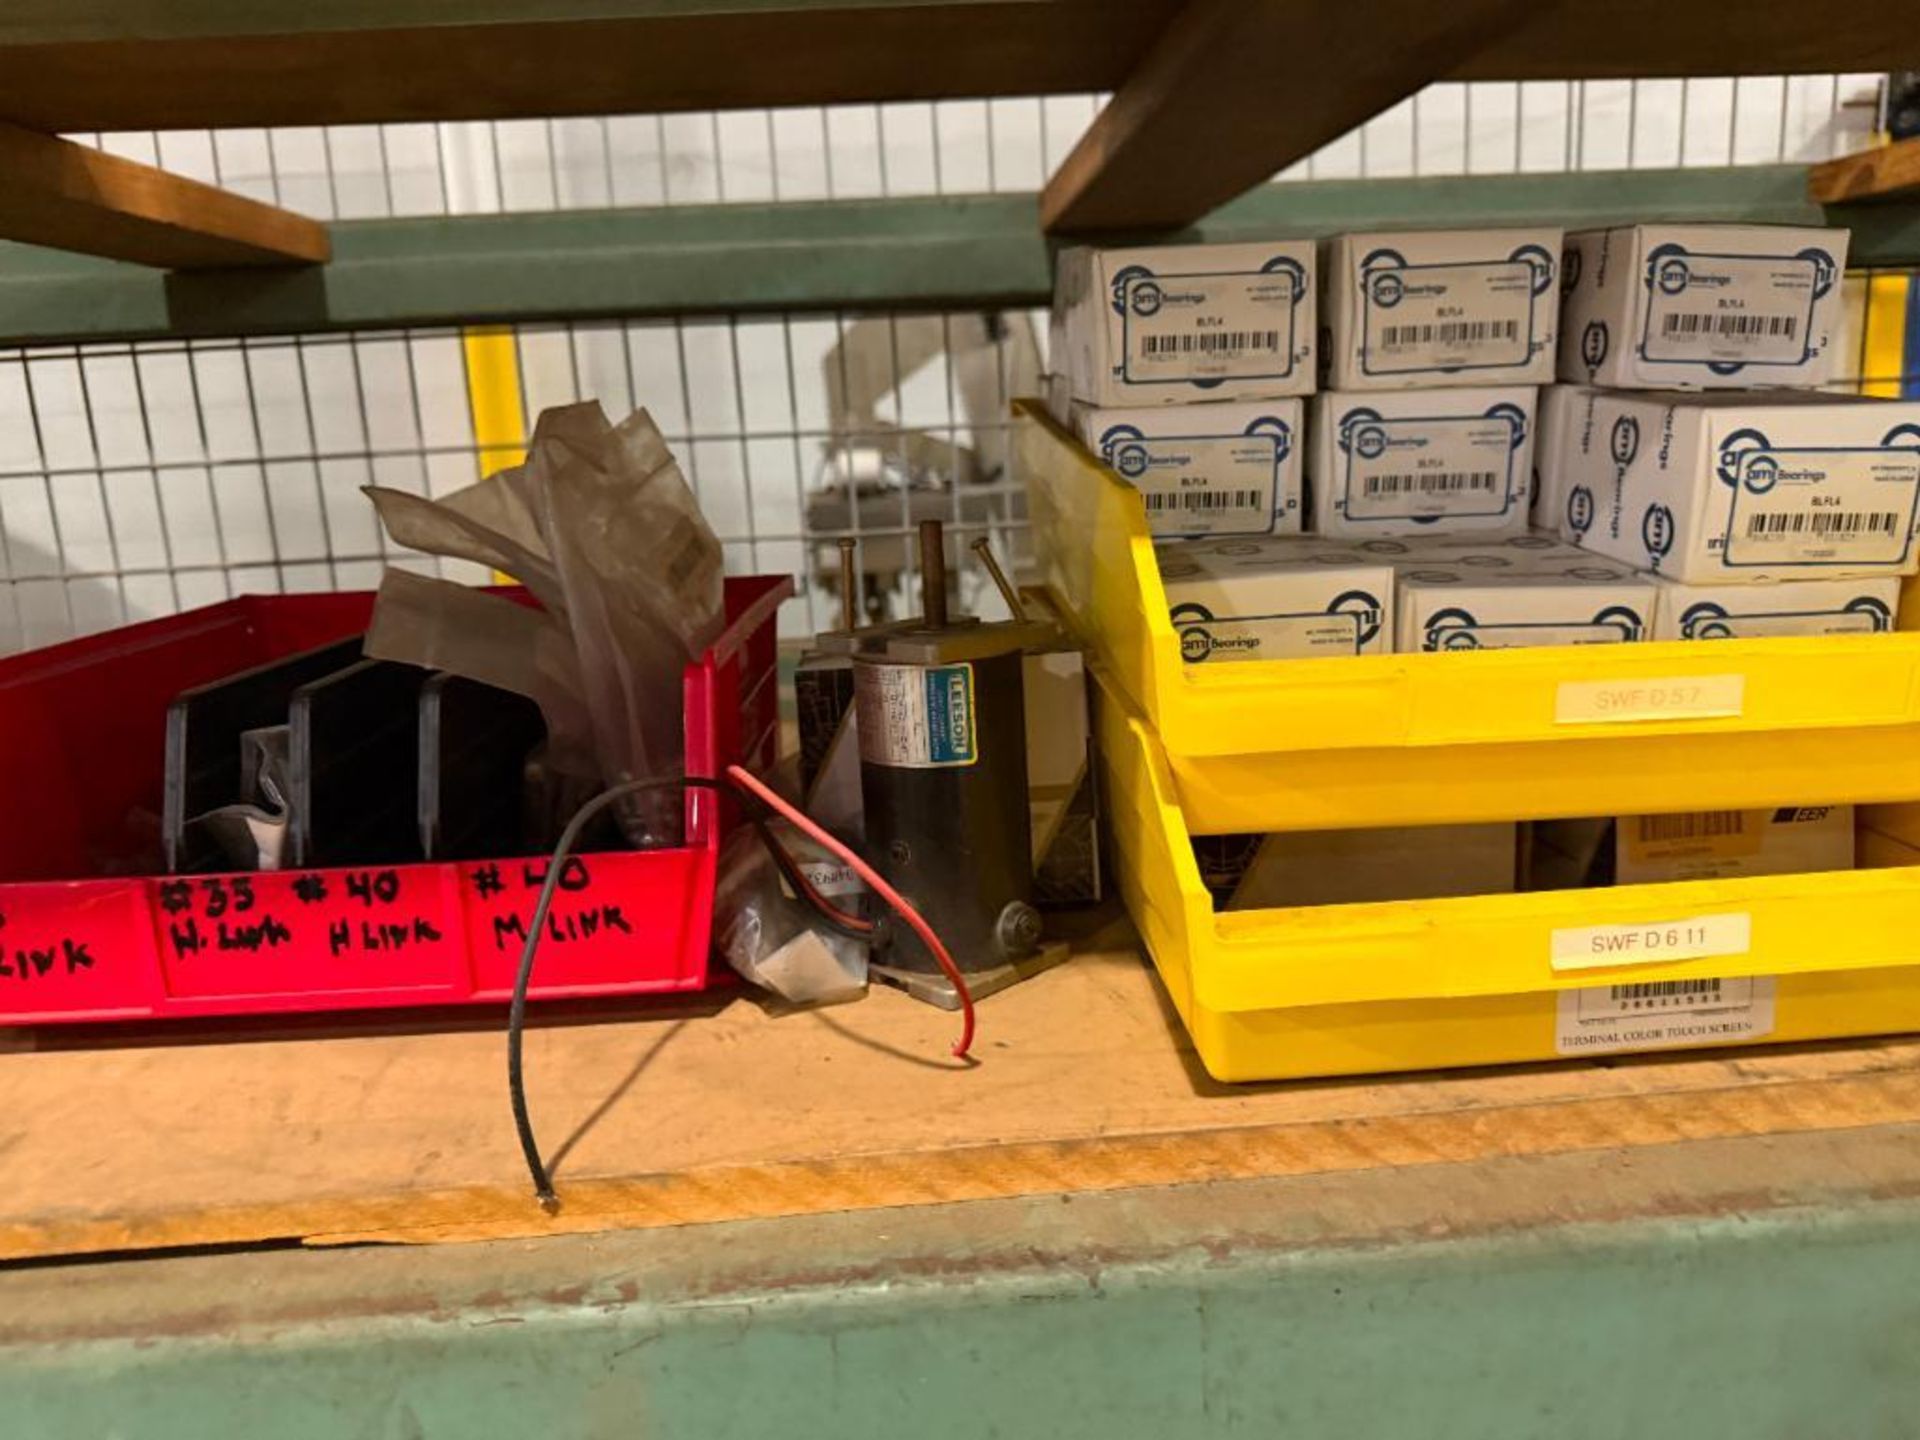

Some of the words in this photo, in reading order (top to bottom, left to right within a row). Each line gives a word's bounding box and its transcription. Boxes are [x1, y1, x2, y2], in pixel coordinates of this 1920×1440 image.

[1778, 468, 1826, 484] Bearings
[1811, 495, 1841, 507] BLFL4
[1211, 635, 1260, 649] Bearings
[1593, 689, 1645, 710] SWF
[1650, 688, 1666, 707] D
[949, 678, 967, 752] LEESON
[1591, 932, 1638, 953] SWF
[1645, 931, 1660, 949] D
[1666, 929, 1678, 946] 6
[1562, 1032, 1619, 1047] TERMINAL
[1623, 1028, 1662, 1042] COLOR
[1666, 1023, 1706, 1037] TOUCH
[1708, 1020, 1752, 1034] SCREEN
